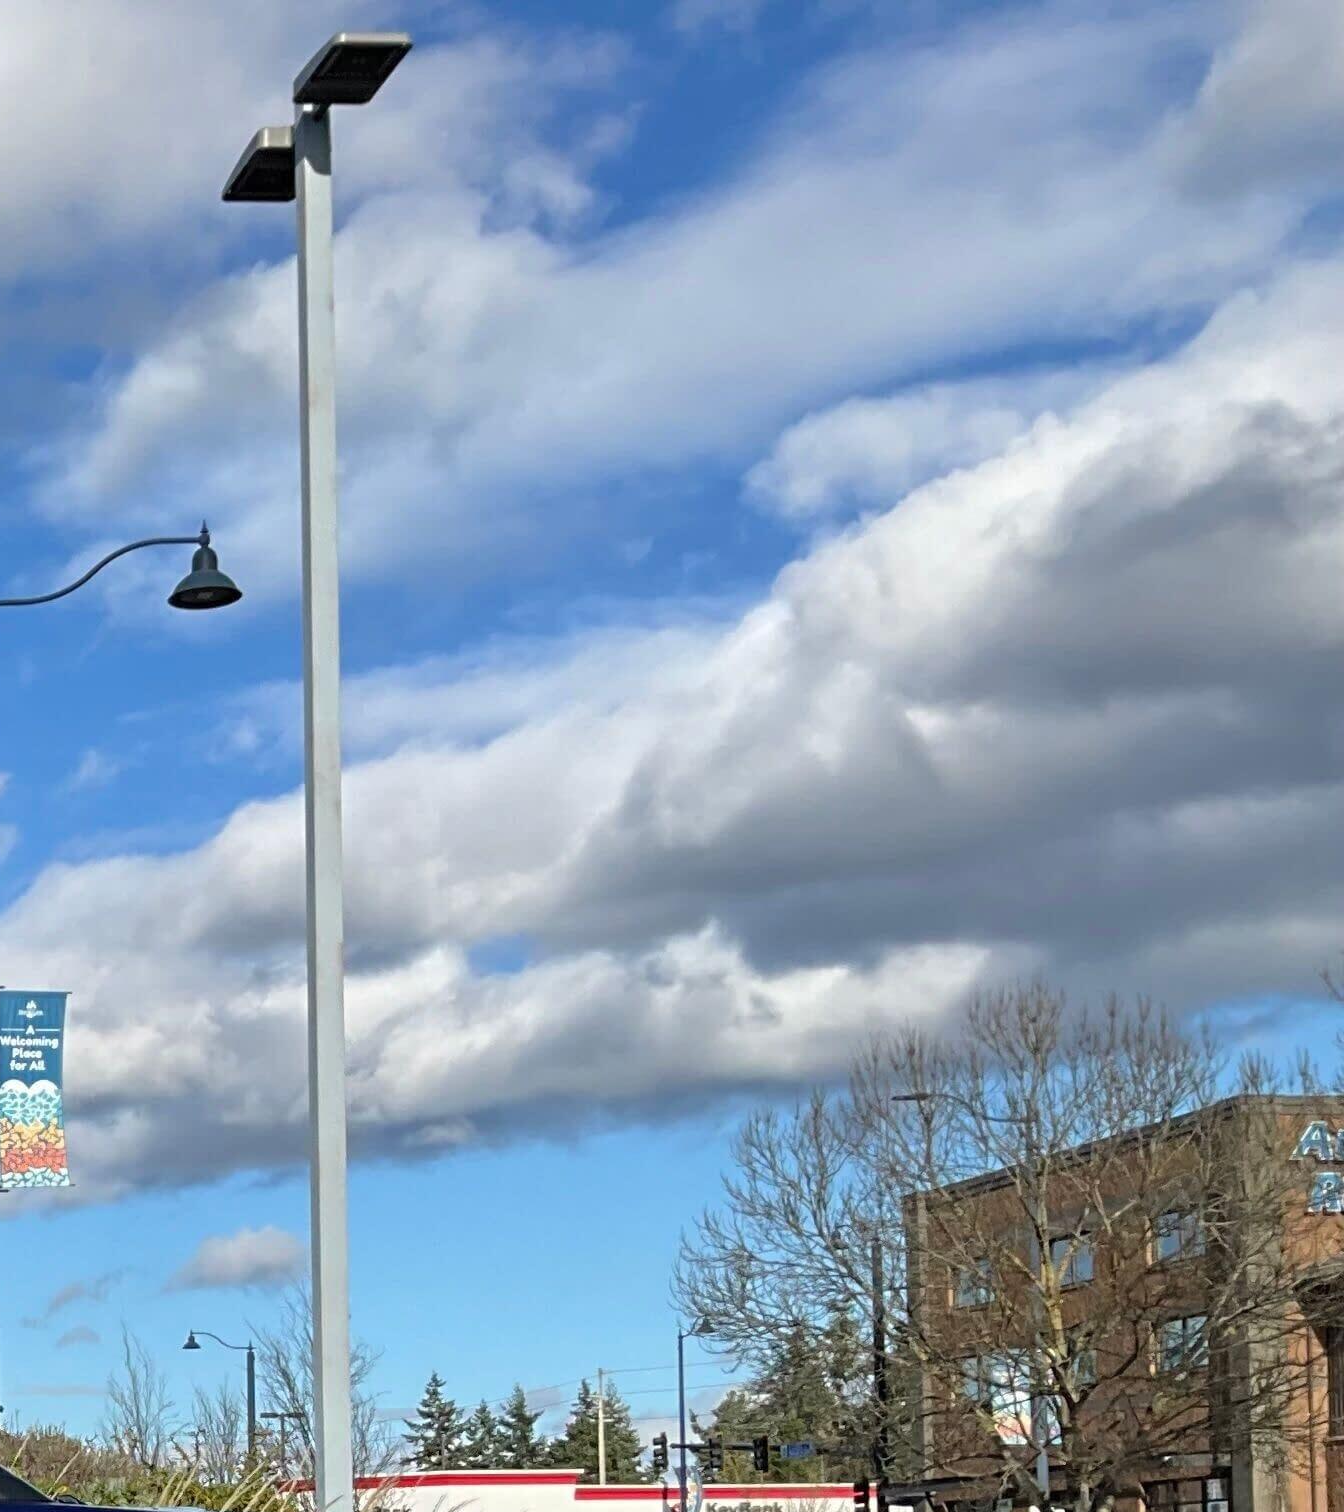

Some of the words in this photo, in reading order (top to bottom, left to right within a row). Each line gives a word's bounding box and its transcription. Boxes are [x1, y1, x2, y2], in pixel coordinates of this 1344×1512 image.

[25, 1024, 35, 1035] A
[0, 1035, 59, 1049] Welcoming
[12, 1047, 43, 1059] Place
[9, 1060, 27, 1071] for
